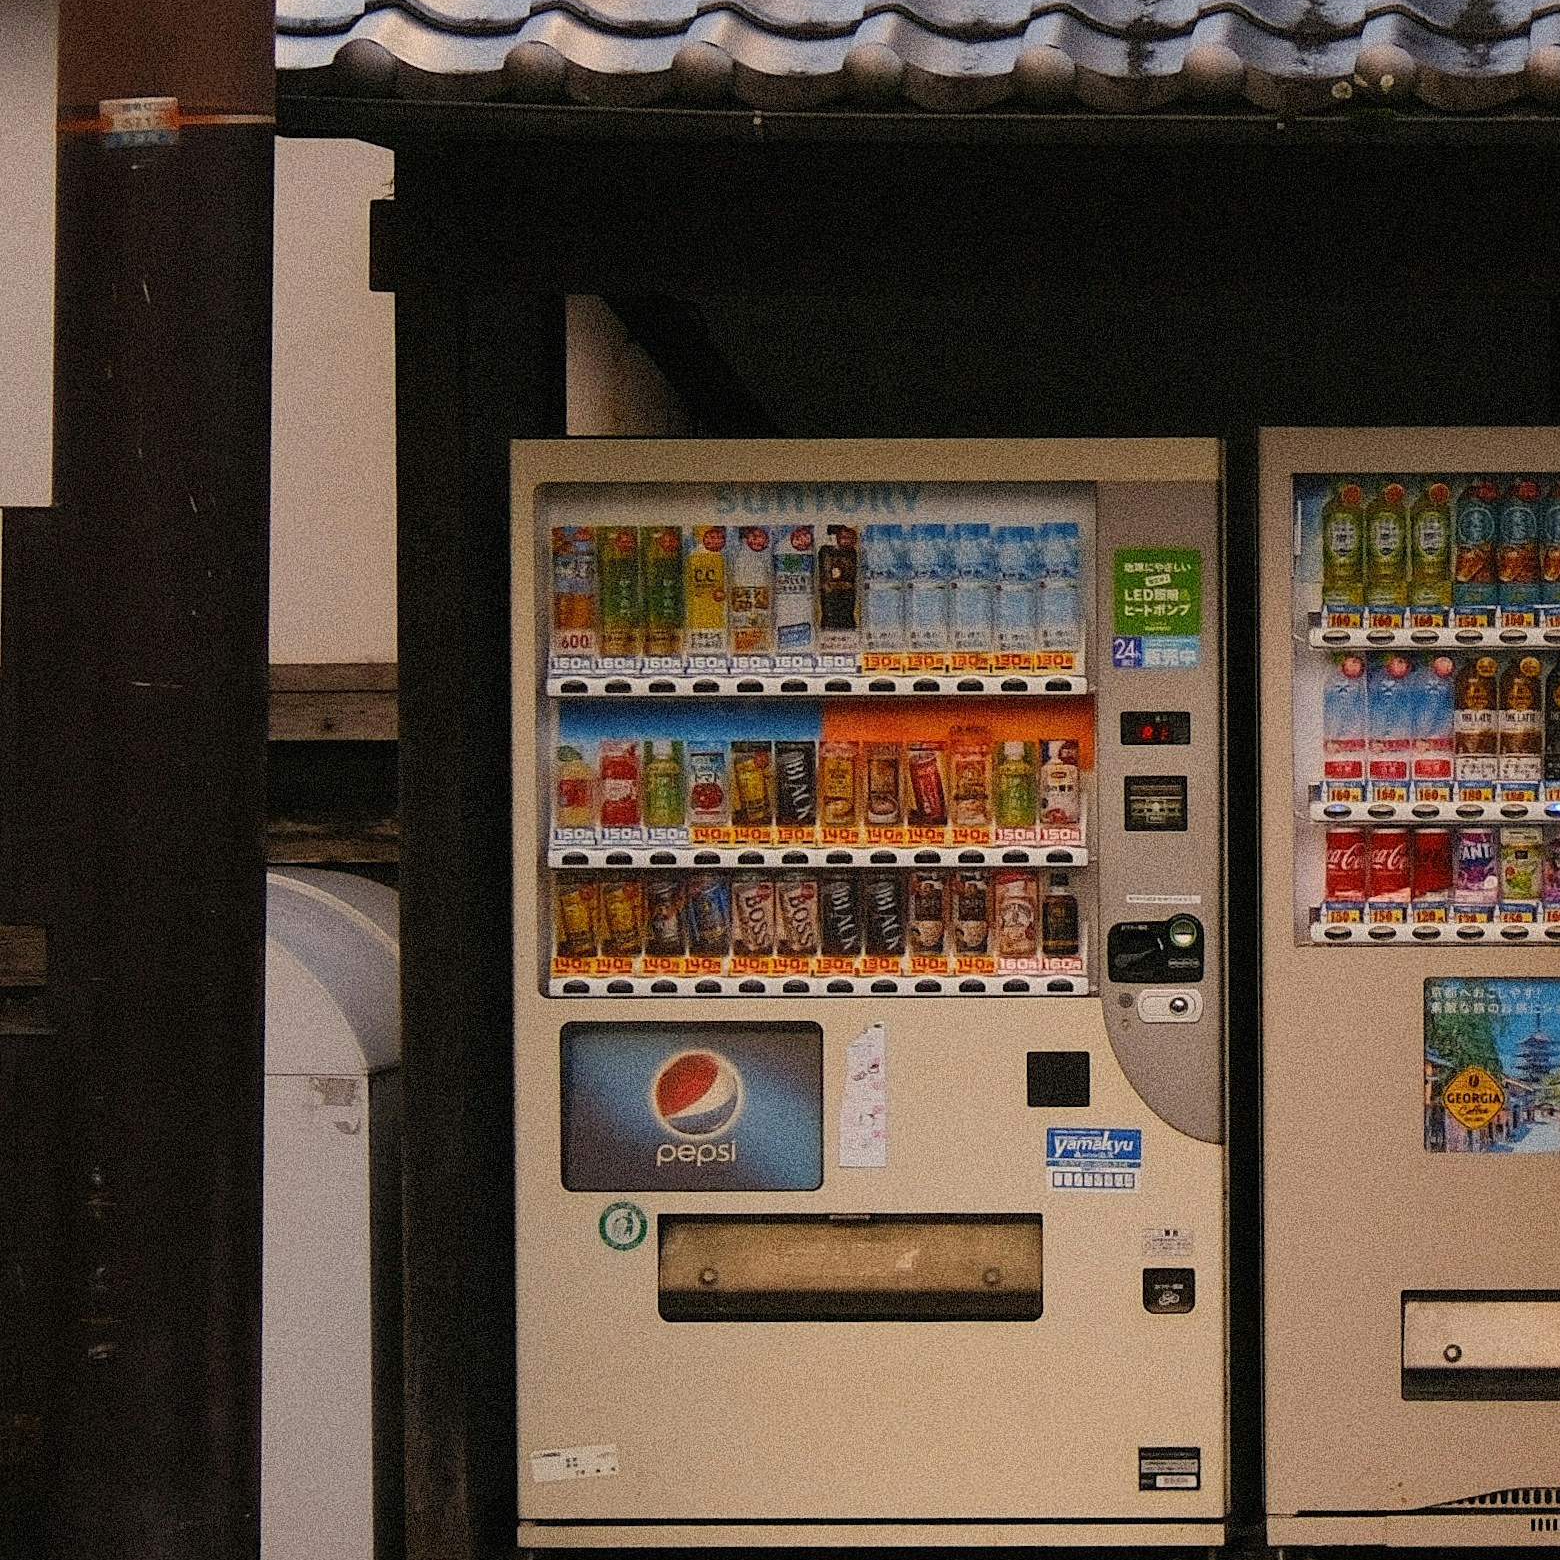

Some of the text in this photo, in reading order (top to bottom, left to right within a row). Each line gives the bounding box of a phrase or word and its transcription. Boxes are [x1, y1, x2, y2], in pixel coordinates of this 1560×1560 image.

[561, 633, 591, 649] 600
[745, 896, 770, 947] BOSS
[789, 896, 814, 947] BOSS
[1446, 1092, 1503, 1105] GEORGIA
[657, 1139, 738, 1167] pepsi
[1053, 1131, 1134, 1159] yamakyu
